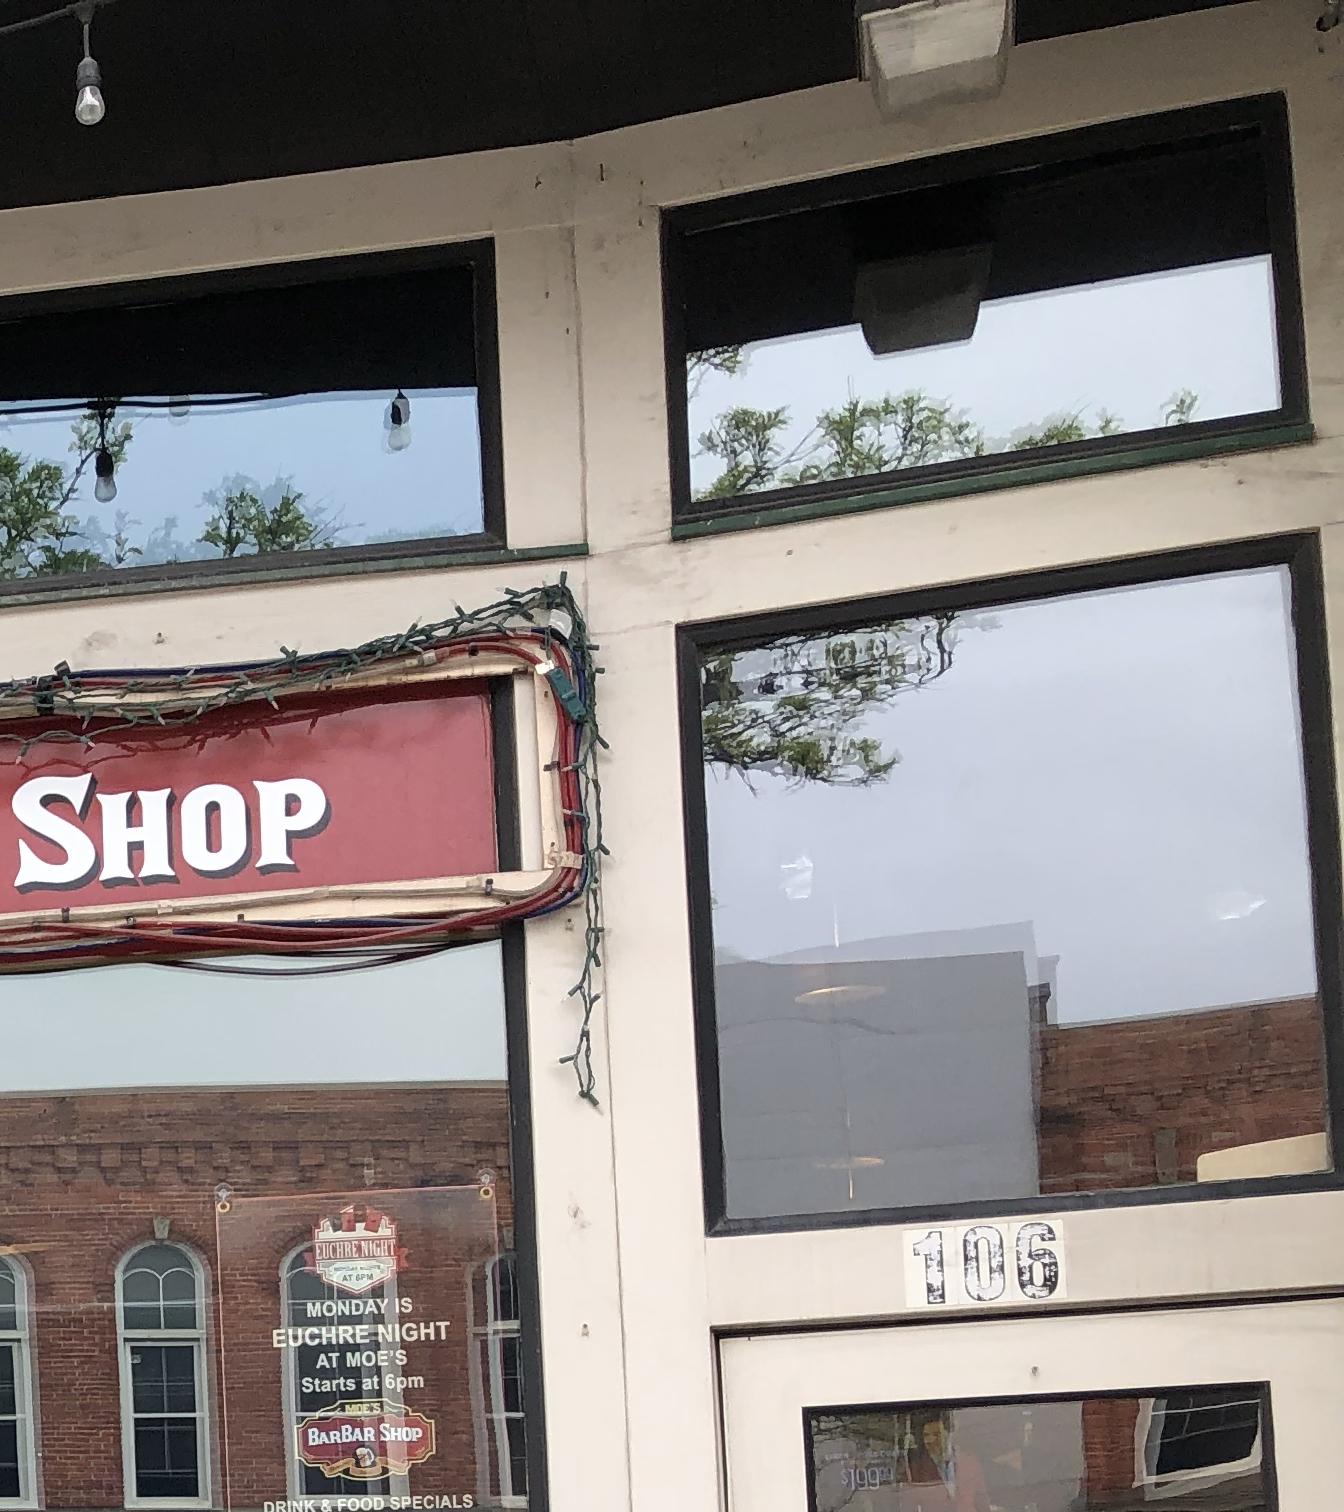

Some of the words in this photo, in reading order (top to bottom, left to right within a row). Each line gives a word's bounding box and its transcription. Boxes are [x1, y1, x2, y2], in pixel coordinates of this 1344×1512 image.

[12, 772, 331, 894] SHOP
[315, 1241, 359, 1259] EUCHRE
[361, 1239, 395, 1257] NIGHT
[912, 1222, 1059, 1305] 106
[306, 1299, 388, 1318] MONDAY
[395, 1297, 413, 1314] IS
[272, 1324, 372, 1348] EUCHRE
[377, 1321, 450, 1343] NIGHT
[316, 1352, 340, 1369] AT
[346, 1350, 407, 1368] MOE'S
[301, 1375, 356, 1393] Starts
[362, 1377, 382, 1391] at
[385, 1373, 425, 1395] 6pm
[345, 1403, 381, 1415] MOE'S
[379, 1423, 423, 1442] SHOP
[320, 1498, 332, 1512] &
[337, 1496, 385, 1512] FOOD
[389, 1494, 474, 1511] SPECIALS
